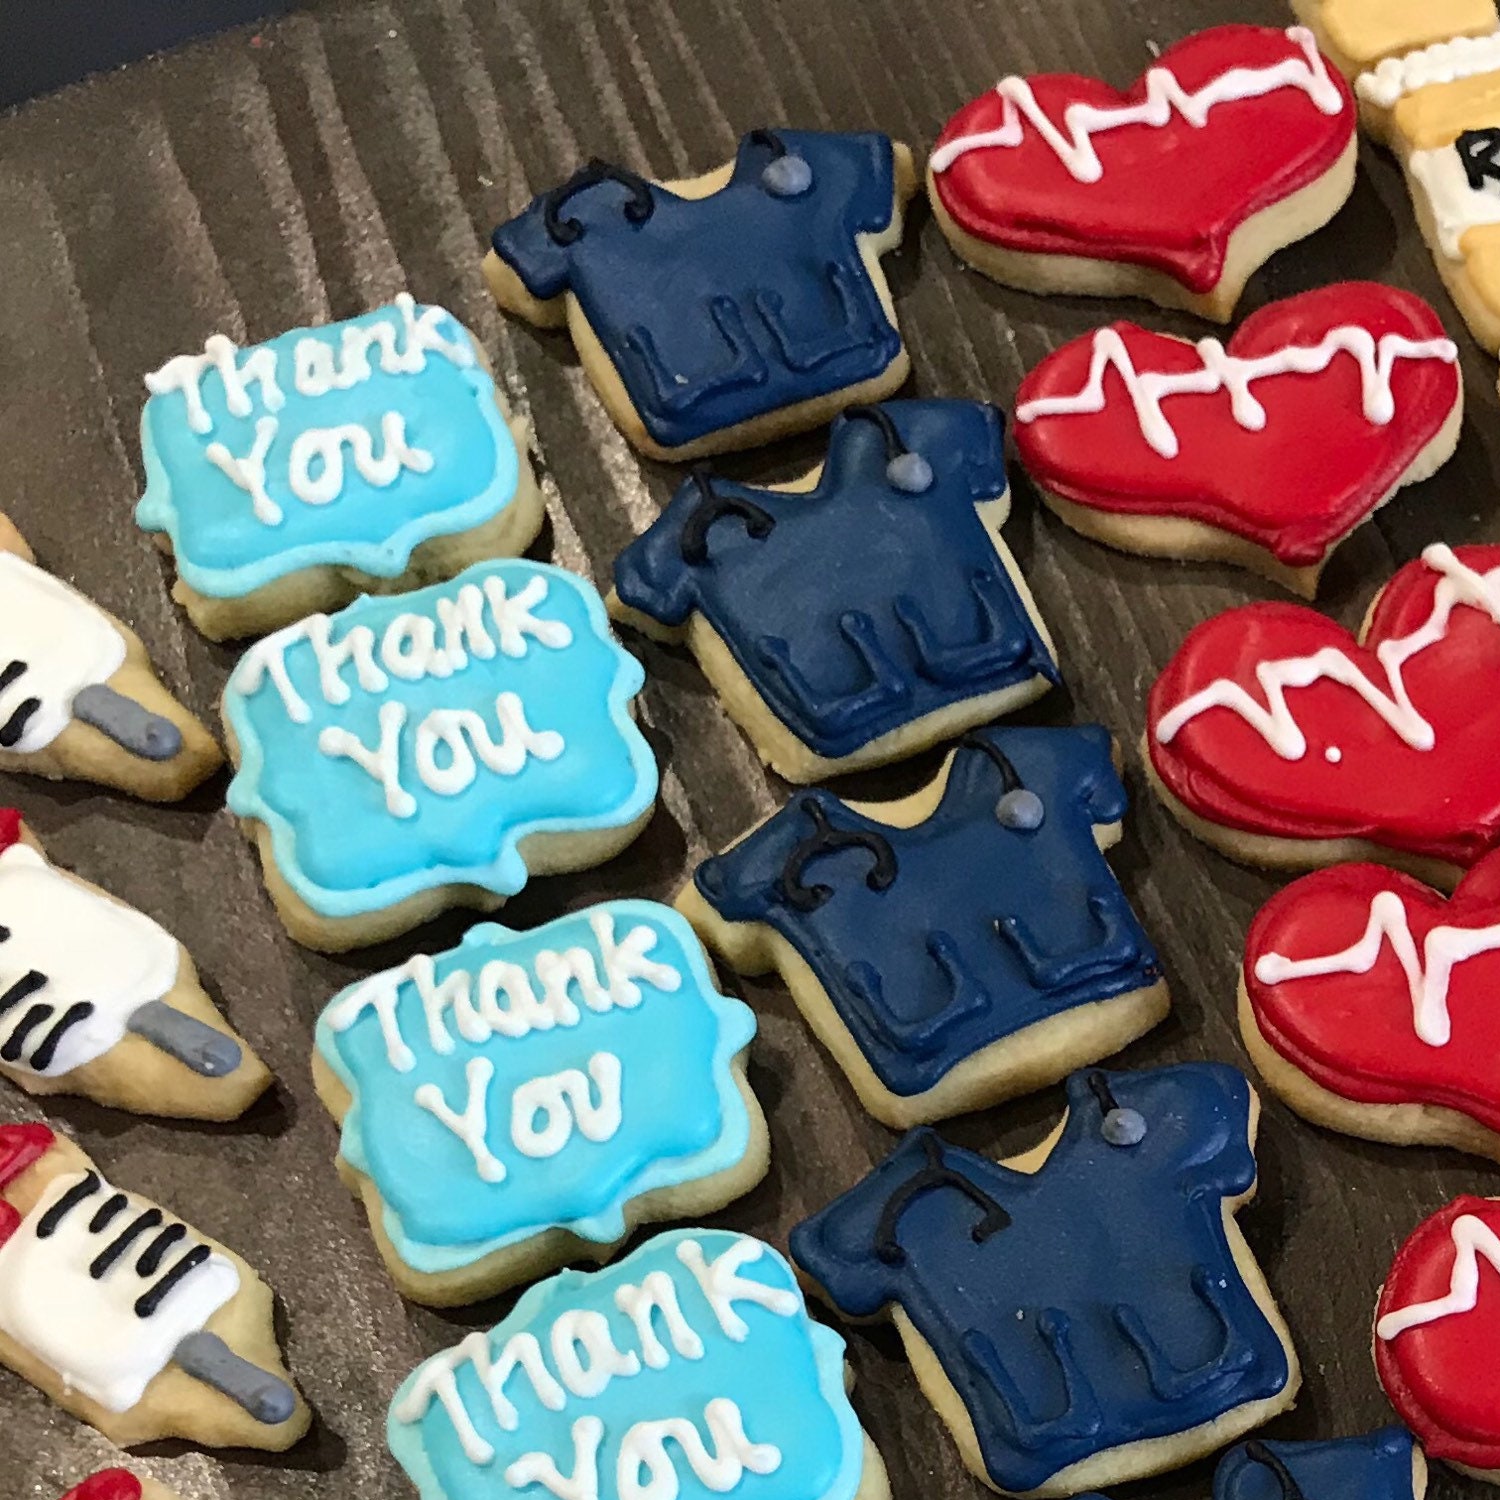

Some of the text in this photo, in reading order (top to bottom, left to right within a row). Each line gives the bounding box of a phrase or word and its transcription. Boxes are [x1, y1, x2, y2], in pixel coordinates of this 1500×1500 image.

[145, 294, 474, 432] Thank
[206, 411, 433, 524] You
[235, 576, 570, 721] Thank
[319, 692, 564, 817] You
[328, 911, 680, 1071] Thank
[396, 1240, 796, 1462] Thank
